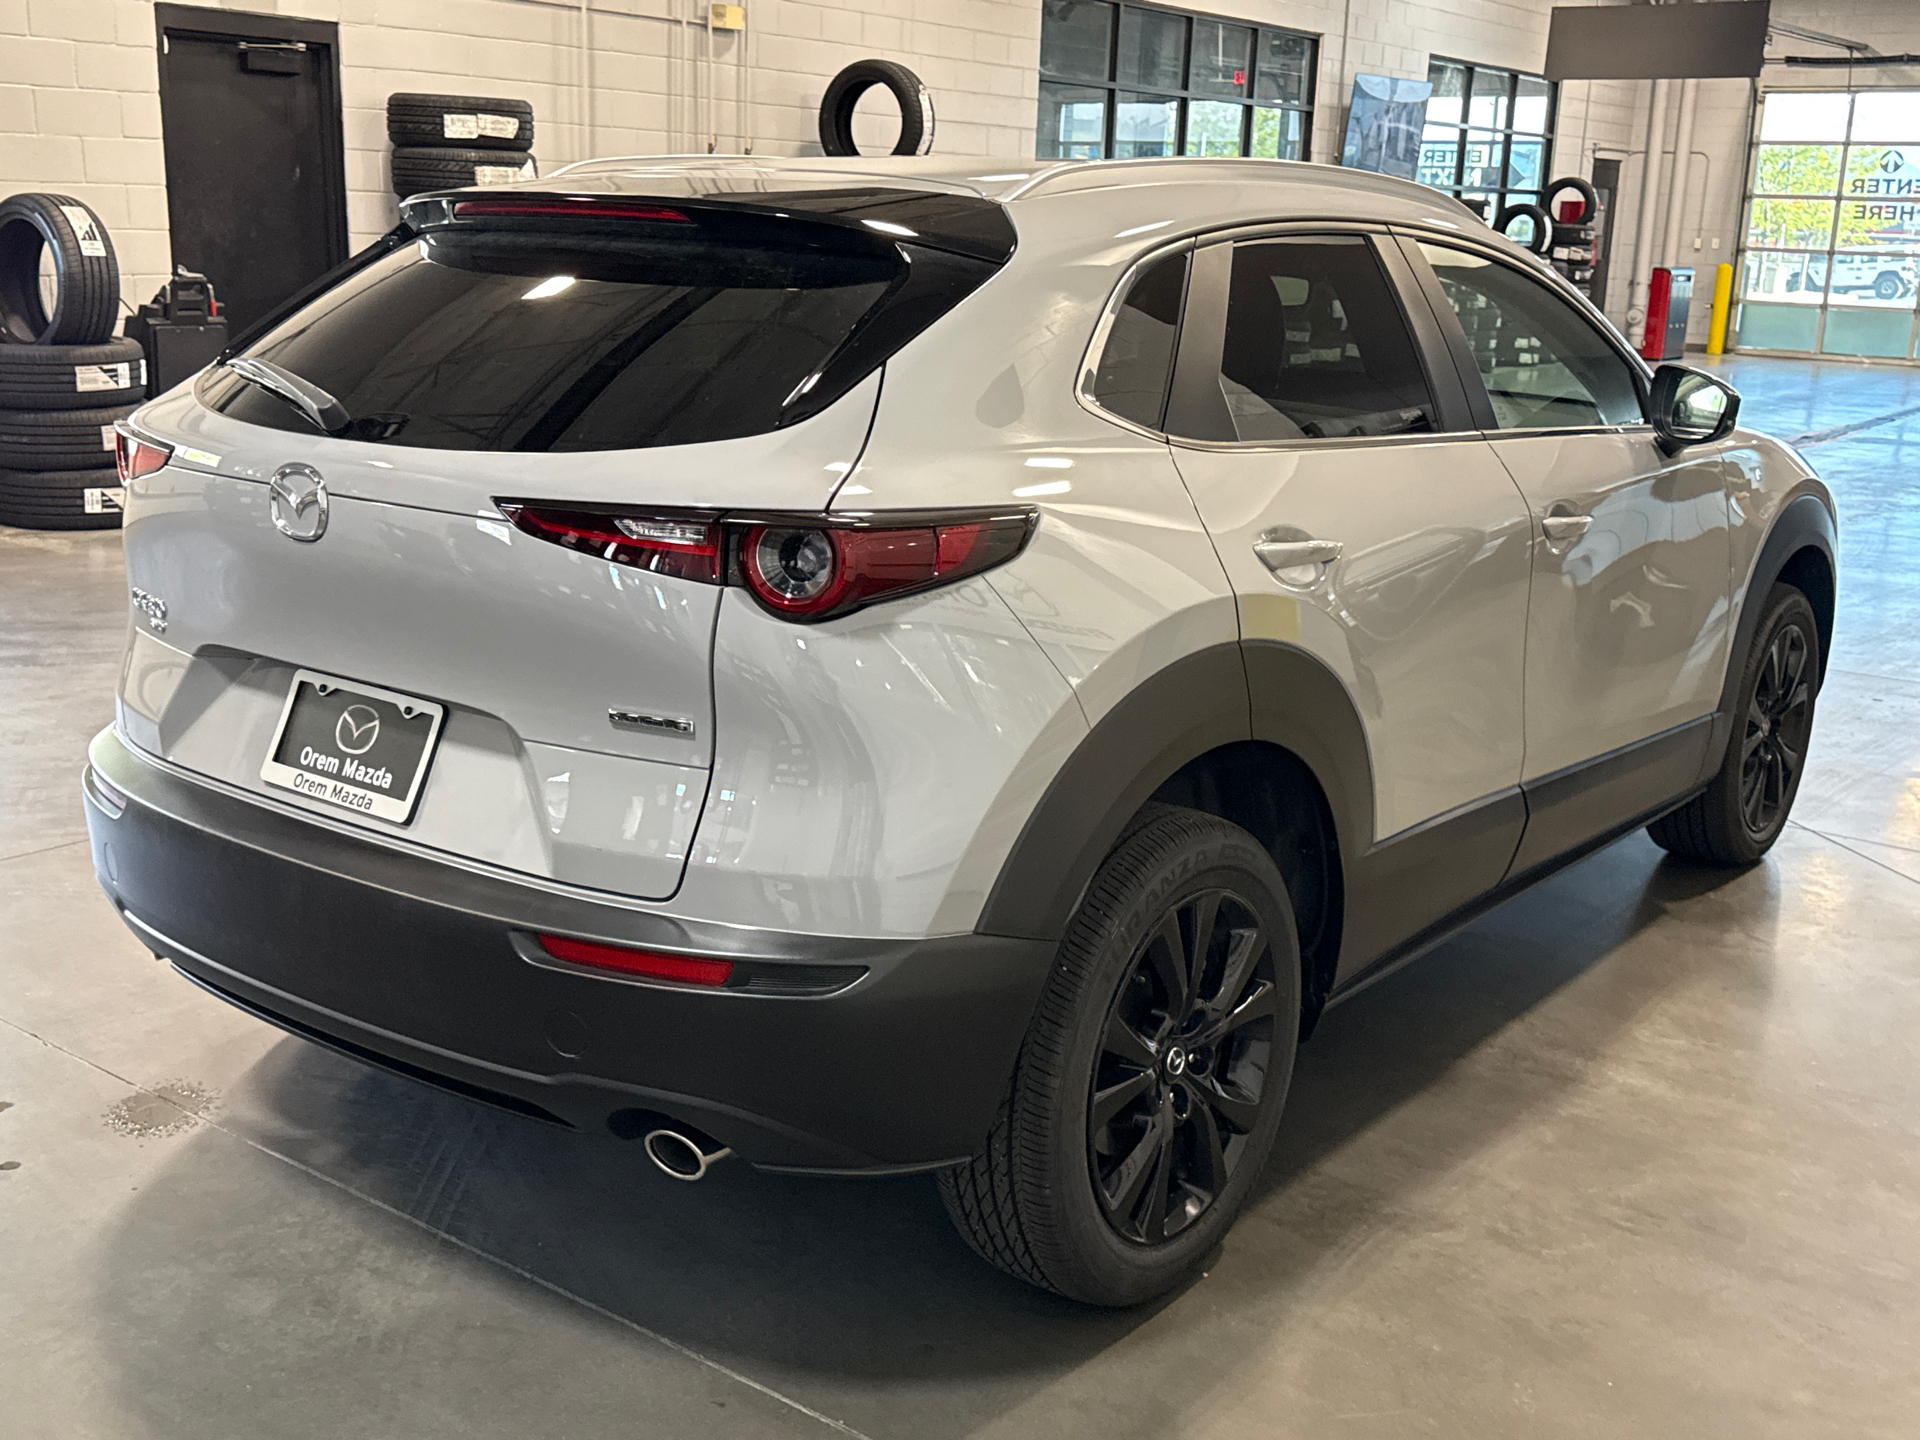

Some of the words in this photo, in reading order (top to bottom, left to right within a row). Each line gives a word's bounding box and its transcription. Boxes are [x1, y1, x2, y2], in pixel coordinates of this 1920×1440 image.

[300, 746, 339, 774] Orem
[342, 758, 393, 789] Mazda
[294, 773, 328, 797] Orem
[330, 784, 373, 811] Mazda
